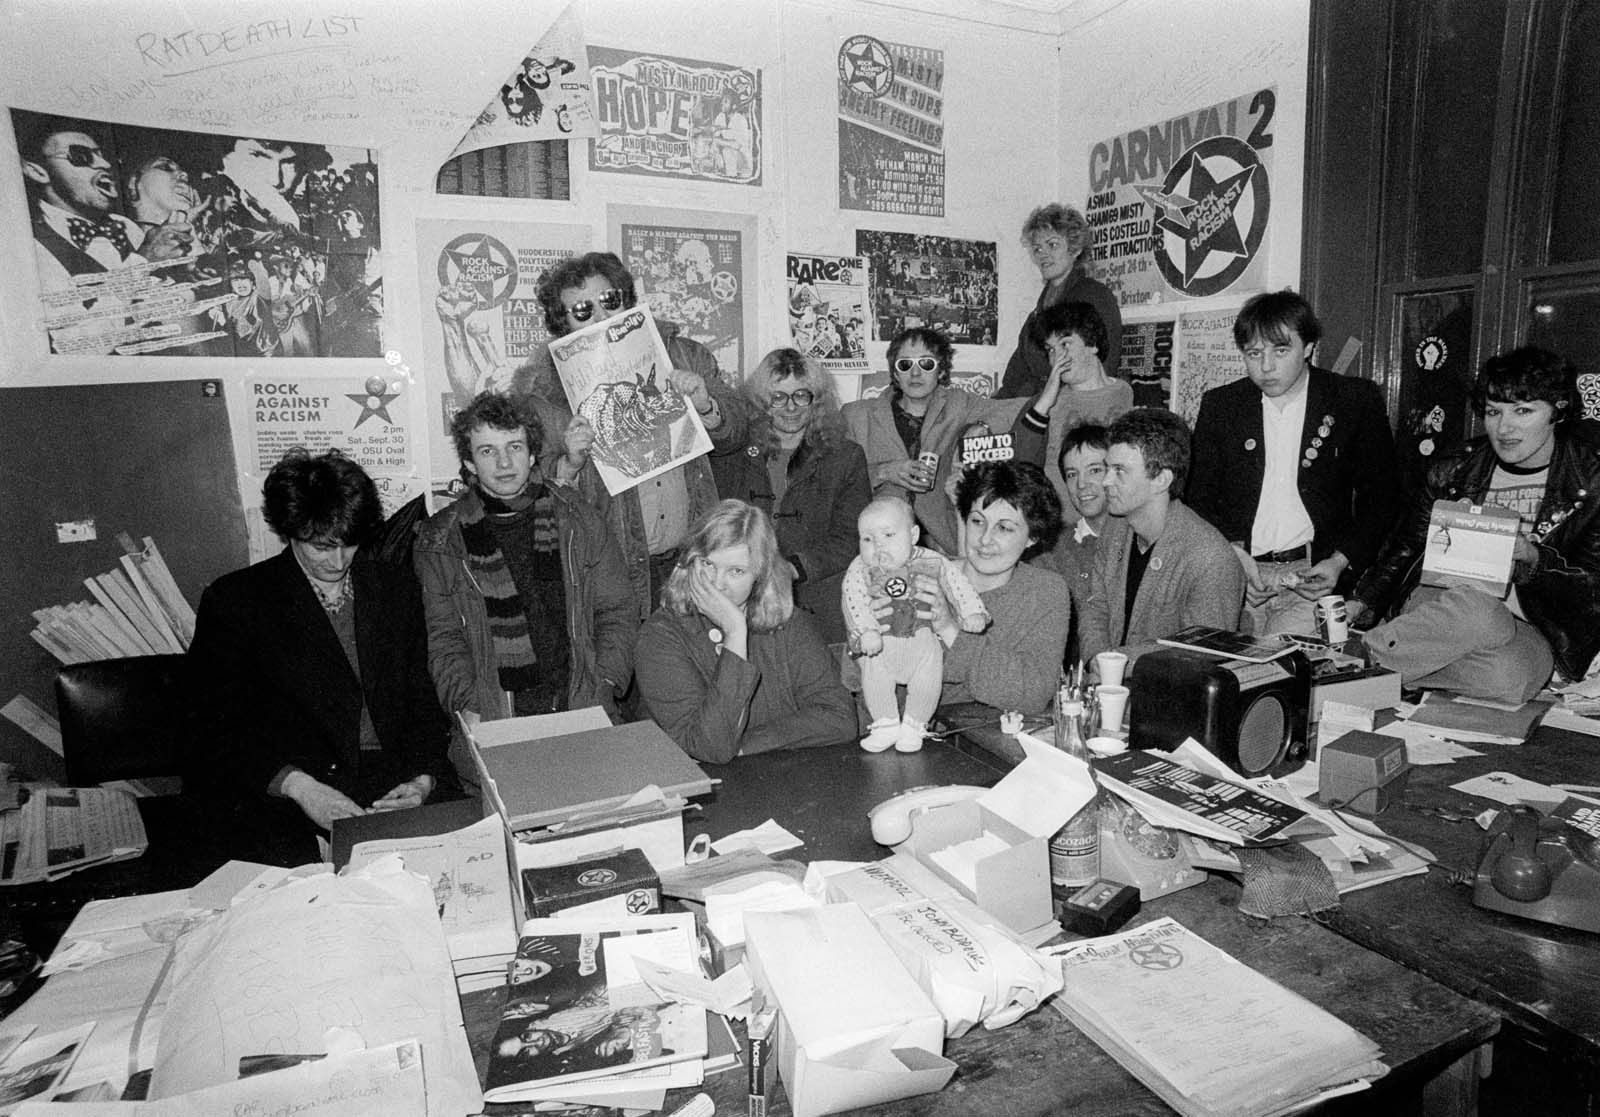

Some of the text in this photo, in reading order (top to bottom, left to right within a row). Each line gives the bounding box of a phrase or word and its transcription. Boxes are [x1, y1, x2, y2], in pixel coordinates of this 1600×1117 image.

[198, 19, 292, 57] DEATH
[302, 16, 362, 39] LIST
[897, 57, 942, 89] MISTY
[596, 77, 689, 134] HOPE
[892, 82, 942, 116] UK SUBS
[1248, 88, 1276, 150] 2
[890, 110, 943, 143] FEELINGS
[907, 162, 926, 173] TOWN
[928, 164, 943, 175] HALL
[1086, 191, 1116, 212] ASWAD
[1187, 189, 1217, 224] ROCK
[1196, 180, 1242, 233] AGAINST
[1119, 201, 1145, 220] MISTY
[1109, 219, 1150, 241] COSTELLO
[1190, 206, 1234, 250] RACISM
[518, 248, 574, 257] HUDDERSFIELD
[1093, 234, 1165, 261] THE ATTRACTIONS
[462, 257, 489, 266] ROCK
[839, 257, 863, 270] ONE
[465, 265, 508, 274] AGAINST
[459, 273, 494, 282] RACISM
[1121, 290, 1151, 305] Brixton
[506, 316, 531, 328] THE
[505, 330, 528, 341] THE
[844, 361, 869, 369] REVIEW
[254, 383, 299, 395] ROCK
[256, 397, 330, 408] AGAINST
[256, 411, 321, 422] RACISM
[390, 427, 404, 435] pm
[392, 436, 404, 444] 30
[963, 433, 1012, 452] HOW TO
[362, 447, 382, 455] OSU
[385, 458, 405, 467] High
[1053, 834, 1097, 846] cozade
